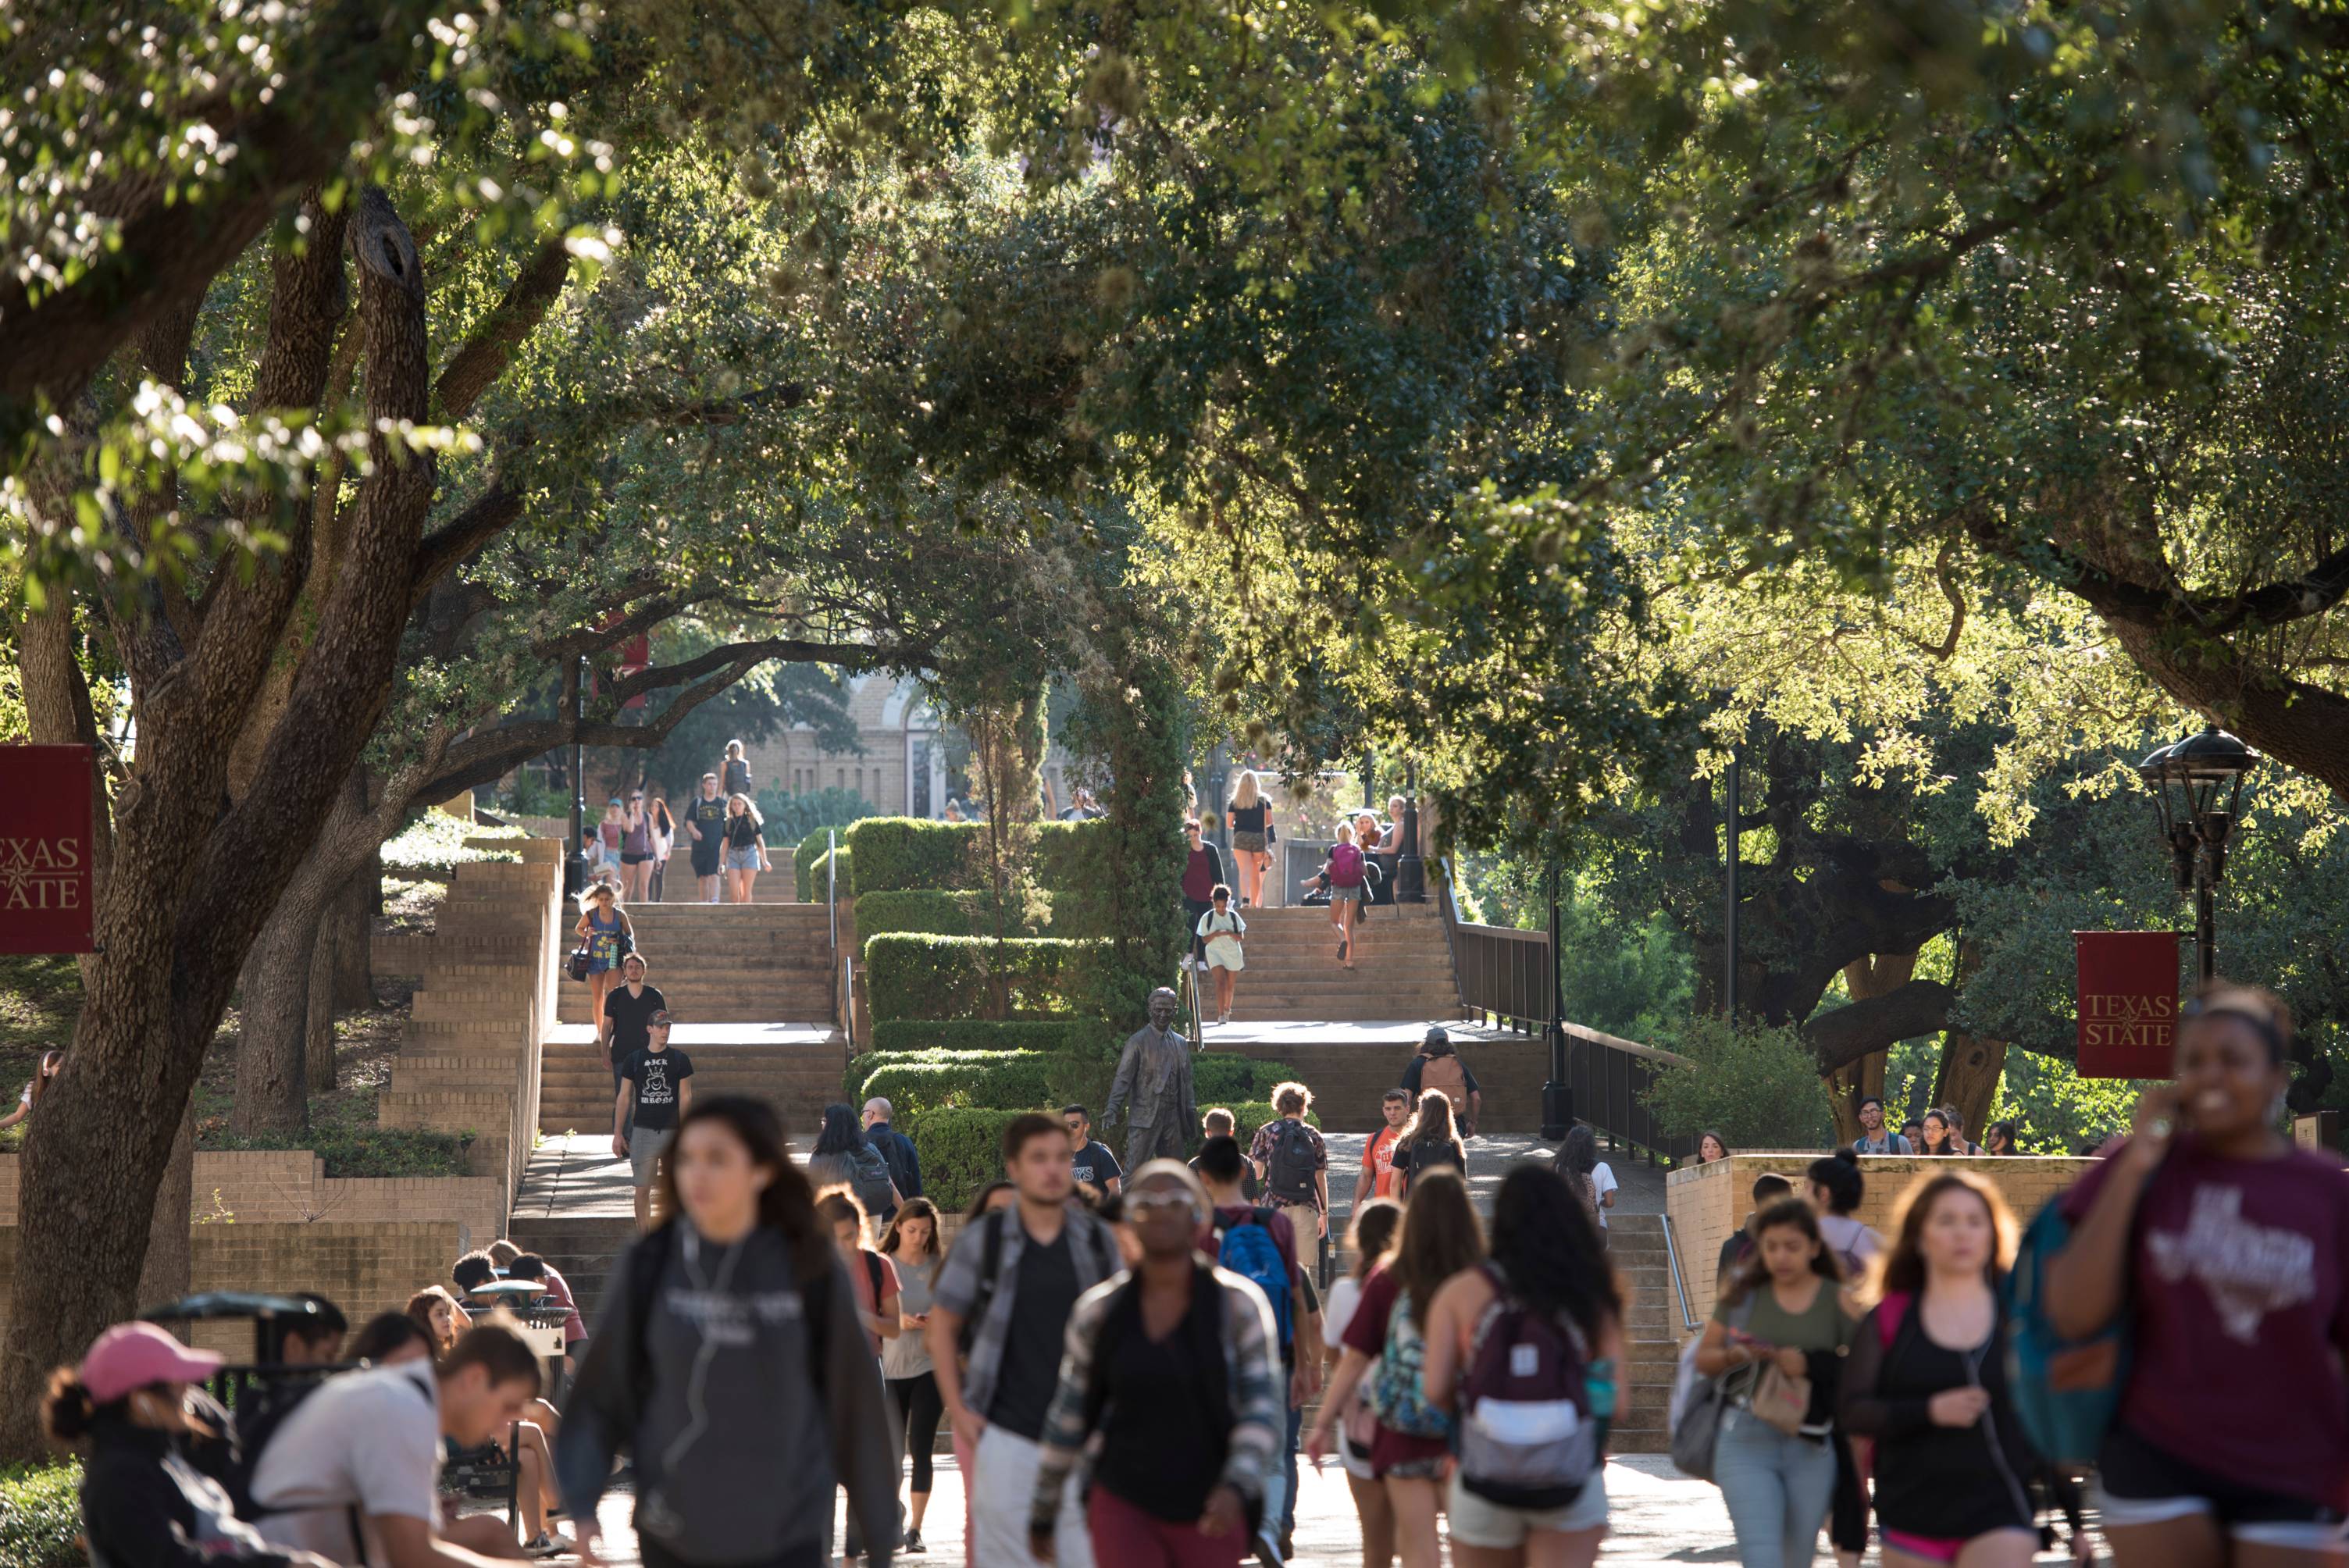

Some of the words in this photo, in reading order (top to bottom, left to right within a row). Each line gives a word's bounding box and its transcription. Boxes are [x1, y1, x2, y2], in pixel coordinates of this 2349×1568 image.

[0, 838, 79, 868] XAS
[0, 879, 80, 910] ATE
[2086, 995, 2171, 1018] TEXAS
[2086, 1024, 2171, 1046] STATE
[1071, 1166, 1094, 1182] YS
